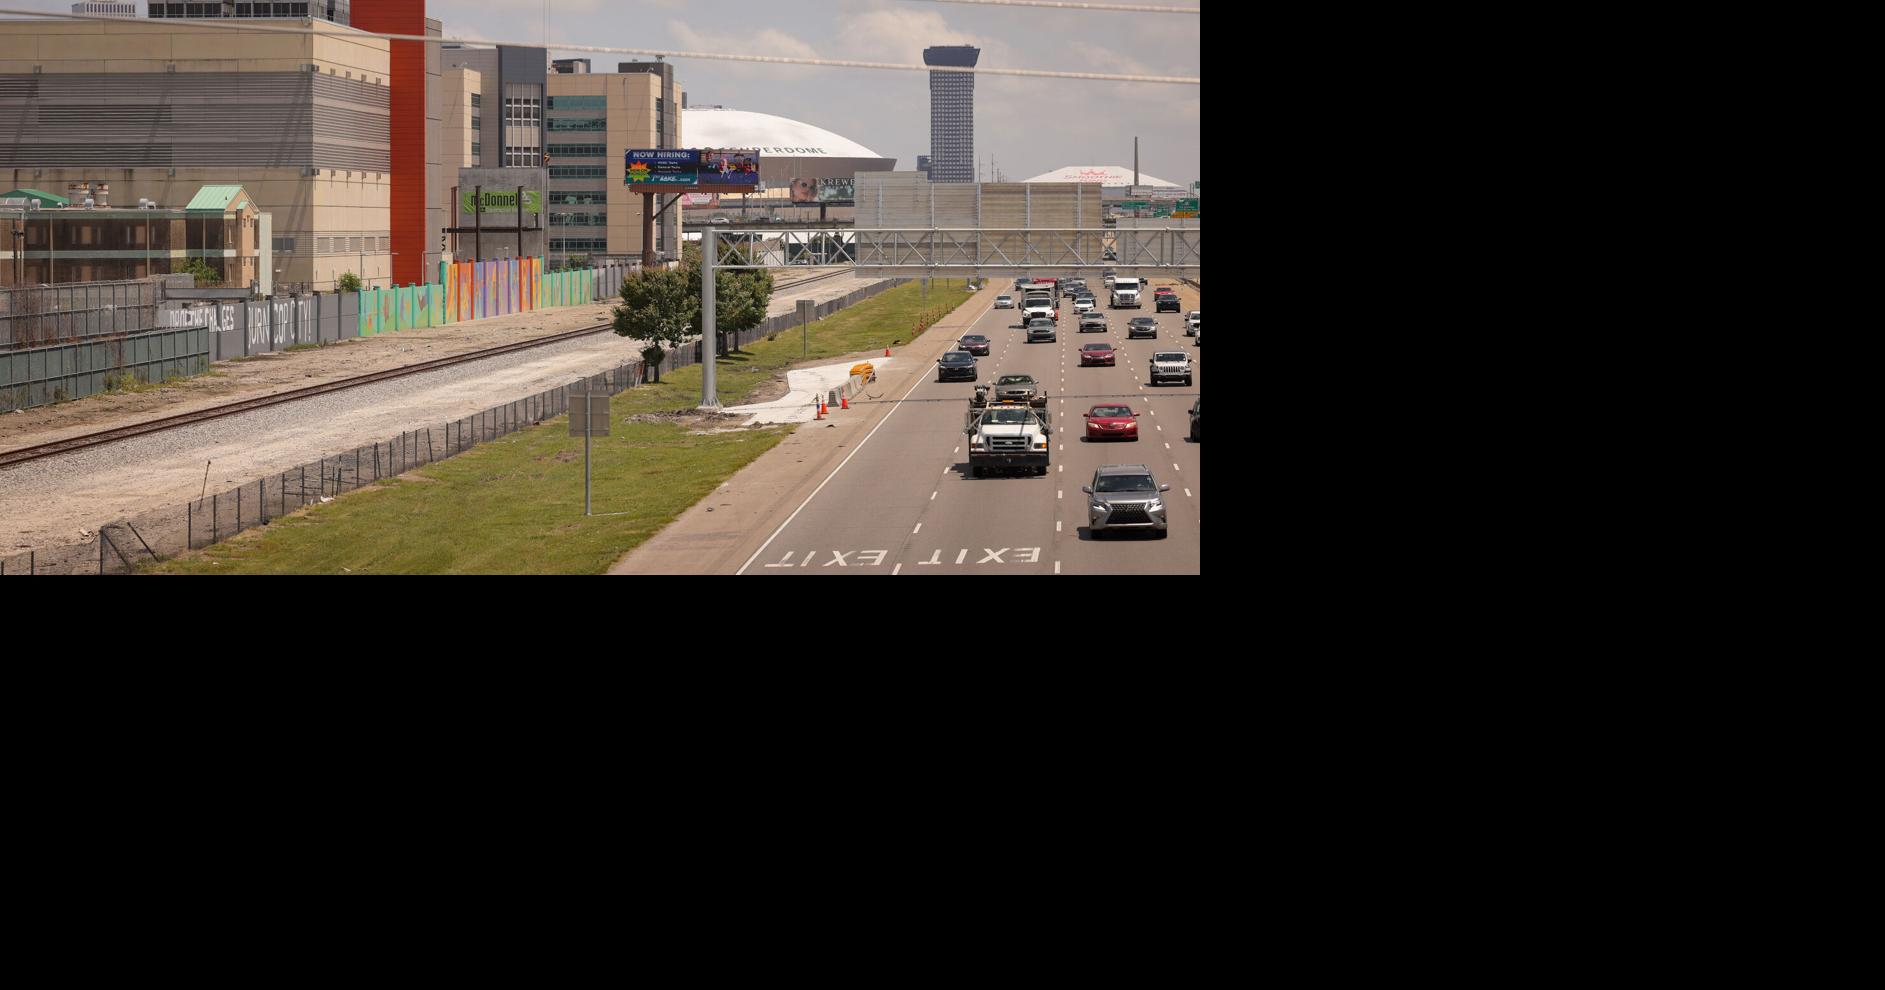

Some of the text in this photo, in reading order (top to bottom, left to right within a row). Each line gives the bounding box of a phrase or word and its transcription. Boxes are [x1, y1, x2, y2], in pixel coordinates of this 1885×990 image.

[657, 151, 690, 159] HIRING:
[204, 305, 235, 333] CHAGES
[290, 298, 312, 342] CTY!
[765, 549, 888, 567] EXIT
[917, 547, 1041, 565] EXIT
